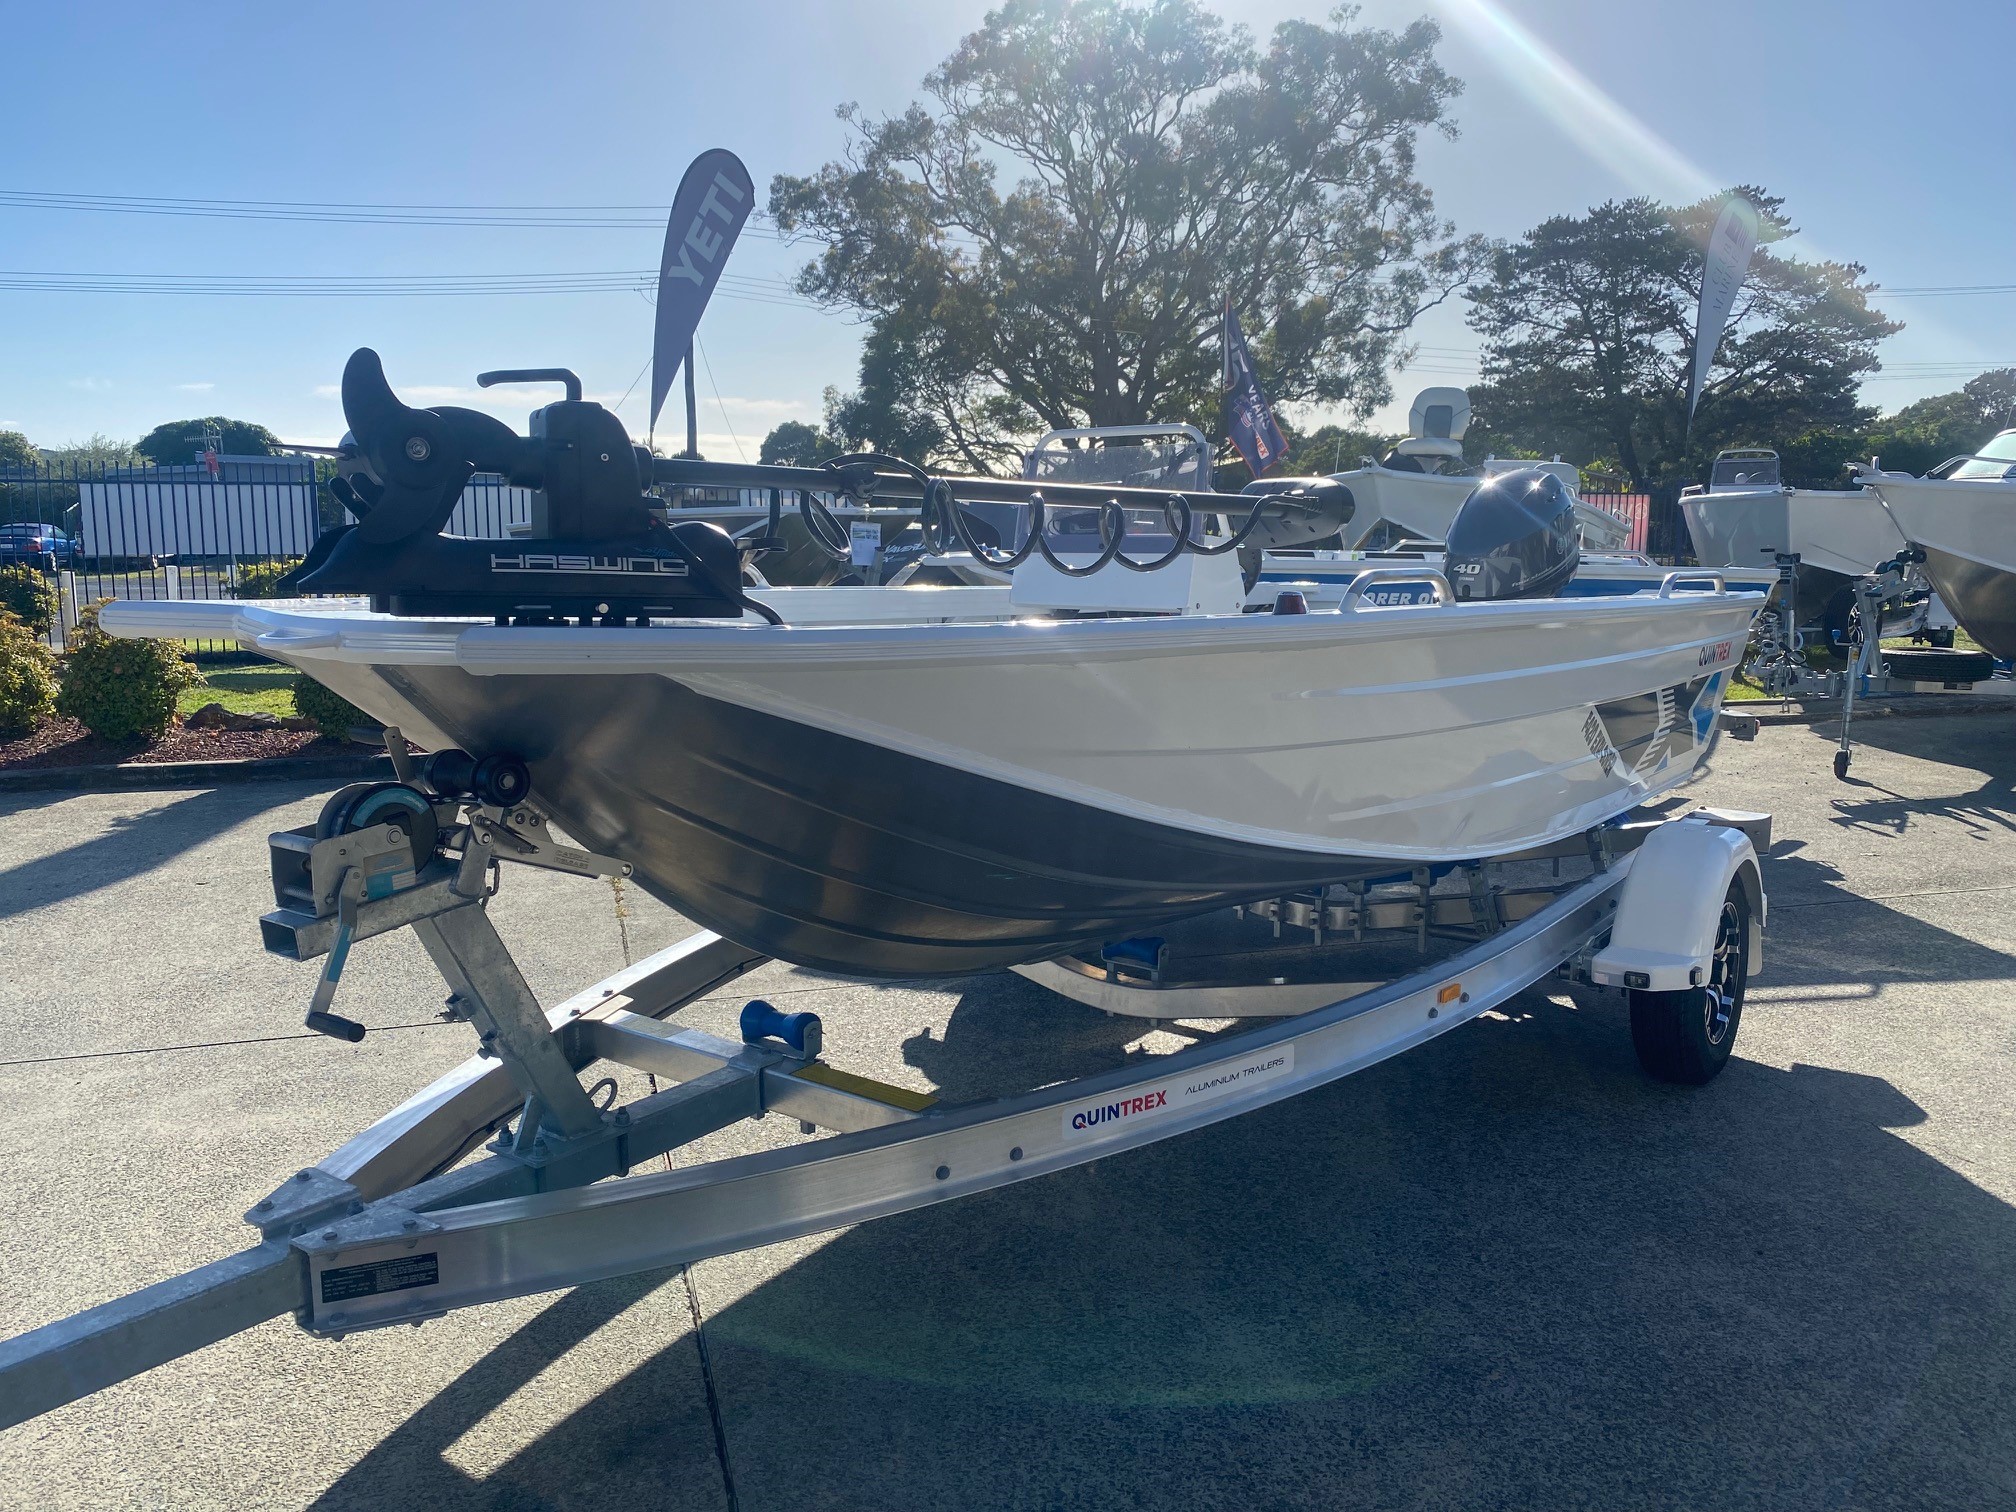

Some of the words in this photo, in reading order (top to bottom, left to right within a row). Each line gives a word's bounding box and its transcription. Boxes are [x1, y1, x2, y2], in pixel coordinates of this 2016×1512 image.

[667, 171, 745, 287] YETI
[490, 553, 689, 577] HASWING
[1453, 563, 1481, 574] 40
[1698, 641, 1733, 667] QUINTREX
[1184, 1072, 1240, 1095] ALUMINIUM
[1242, 1057, 1285, 1078] TRAILERS
[1072, 1090, 1167, 1129] QUINTREX
